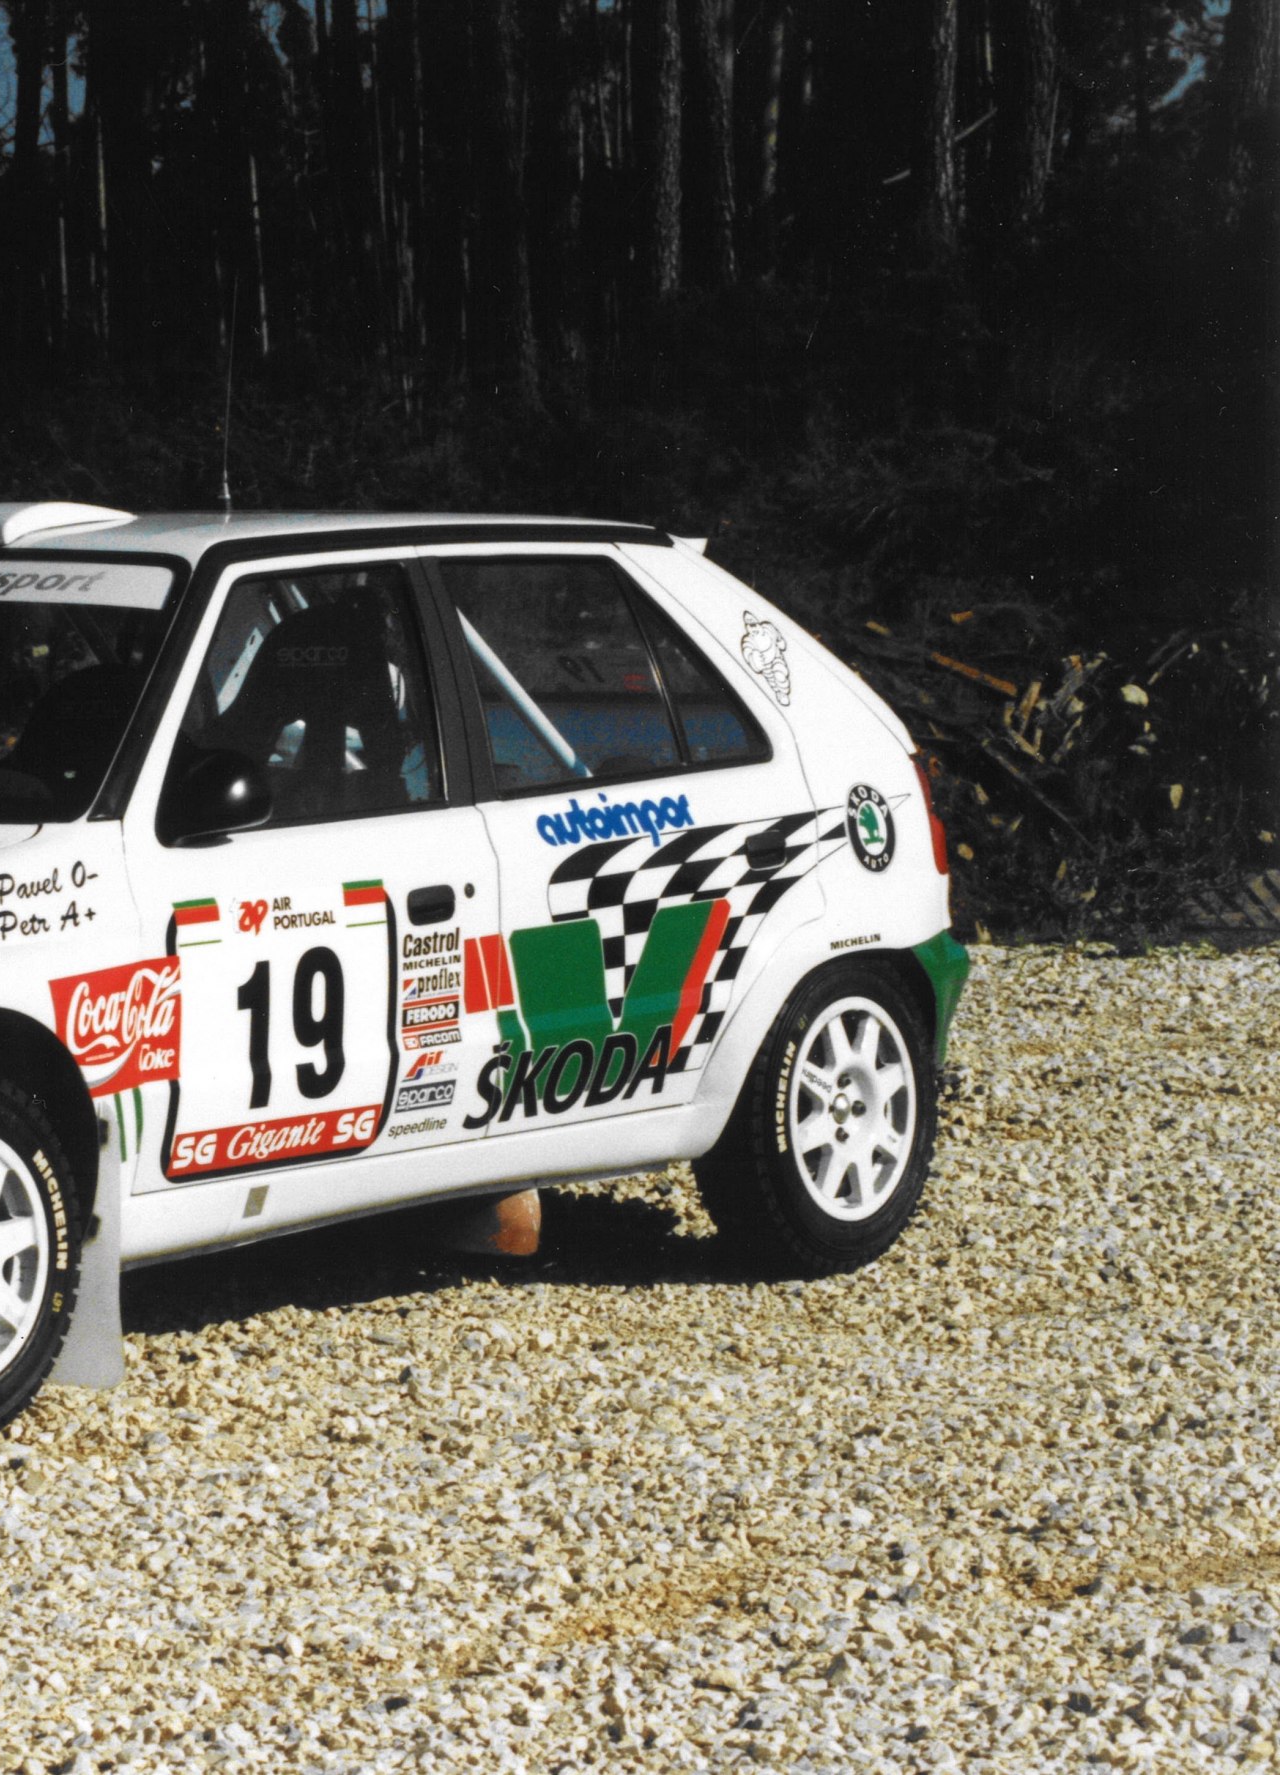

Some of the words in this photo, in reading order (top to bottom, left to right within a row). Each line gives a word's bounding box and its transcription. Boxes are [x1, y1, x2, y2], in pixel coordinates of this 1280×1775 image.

[536, 793, 695, 847] autoimpor
[863, 852, 889, 869] AUTO
[272, 896, 291, 911] AIR
[273, 910, 336, 930] PORTUGAL
[403, 926, 460, 959] Castrol
[830, 933, 881, 950] MICHELIN
[403, 955, 461, 971] MICHELIN
[417, 967, 461, 998] proflex
[66, 966, 180, 1055] Coca-Cola
[406, 1003, 455, 1025] FERODO
[237, 946, 345, 1109] 19
[139, 1043, 175, 1071] Coke
[463, 1023, 672, 1129] ŠKODA
[398, 1084, 454, 1109] sparco
[776, 1041, 797, 1153] MICHELIN
[172, 1133, 217, 1169] SG
[226, 1117, 326, 1159] Gigante
[332, 1109, 376, 1144] SG
[388, 1116, 447, 1139] speedline
[32, 1149, 68, 1270] MICHELIN
